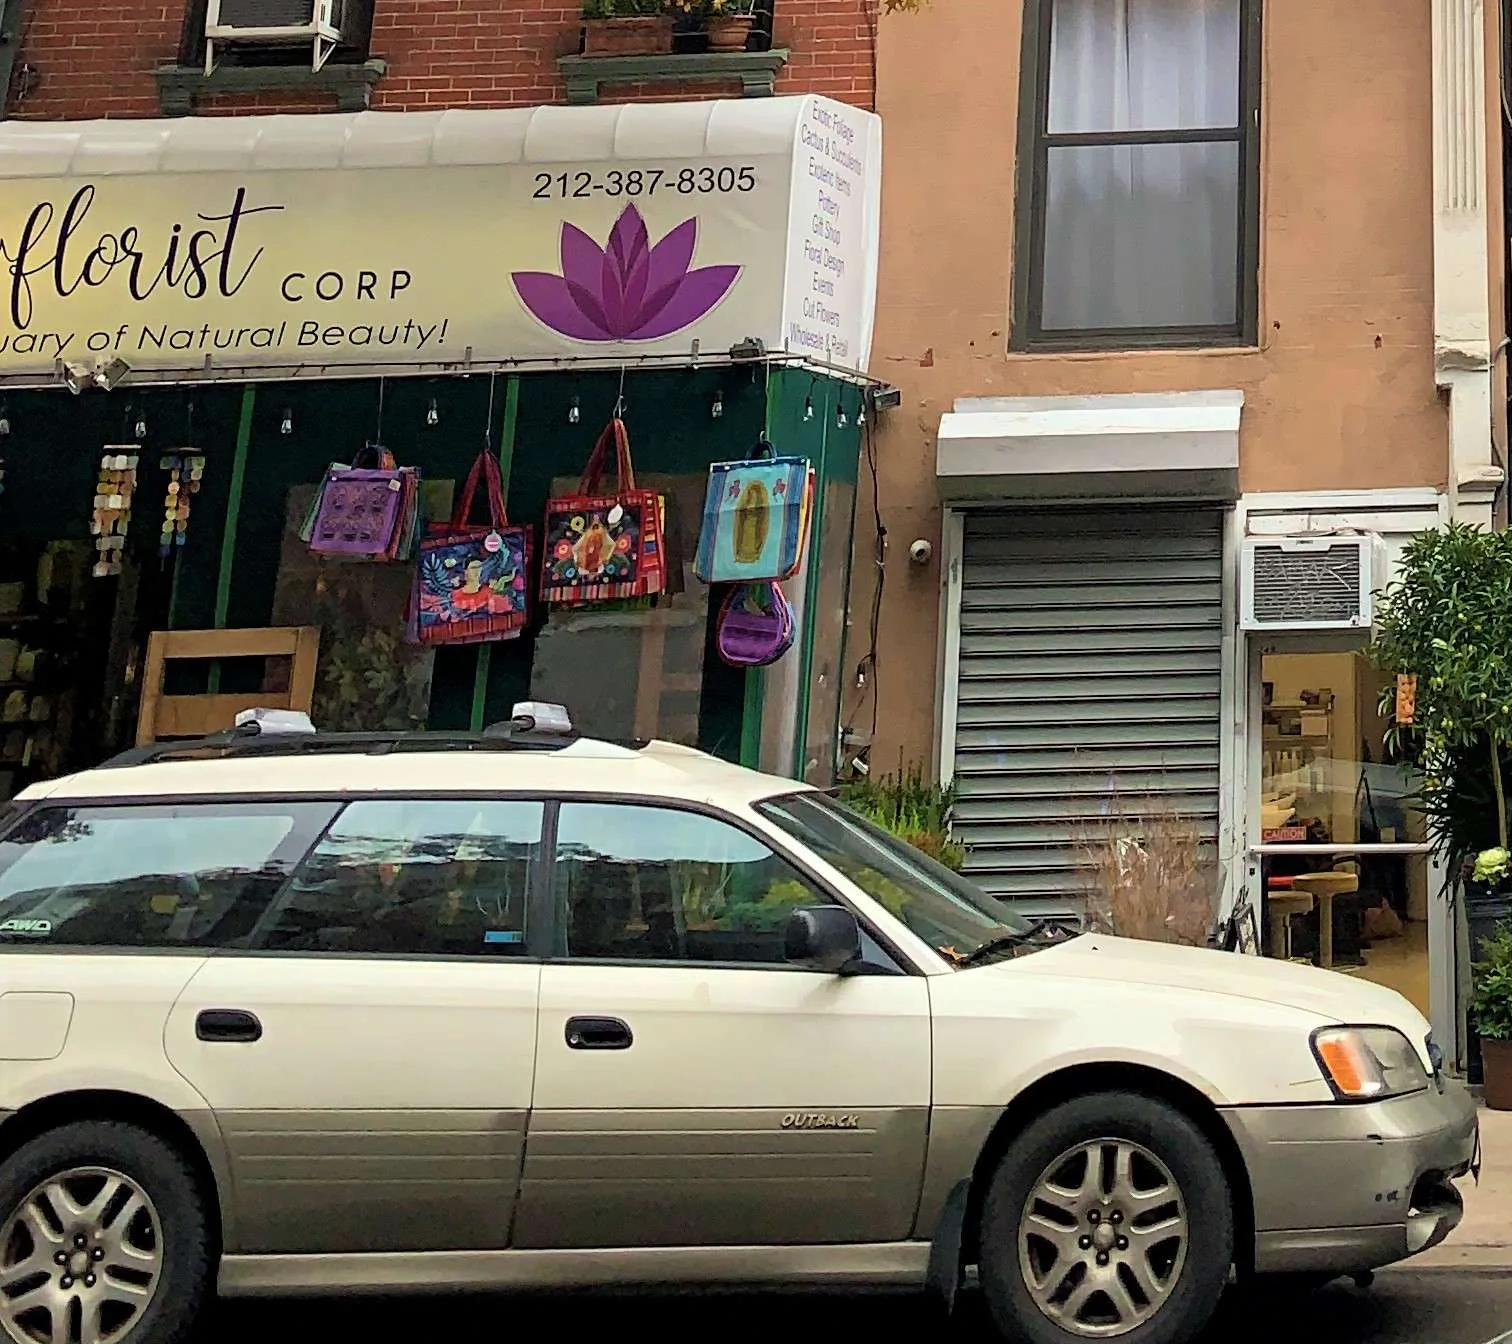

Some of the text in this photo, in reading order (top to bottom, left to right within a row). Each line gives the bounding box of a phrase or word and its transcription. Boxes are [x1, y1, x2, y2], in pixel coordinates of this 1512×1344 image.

[532, 167, 755, 199] 212-387-8305
[0, 185, 285, 330] florist
[282, 270, 411, 302] CORP
[87, 324, 129, 350] of
[137, 321, 286, 350] Natural
[297, 318, 449, 349] Beauty!
[781, 1113, 859, 1127] OUTBACK
